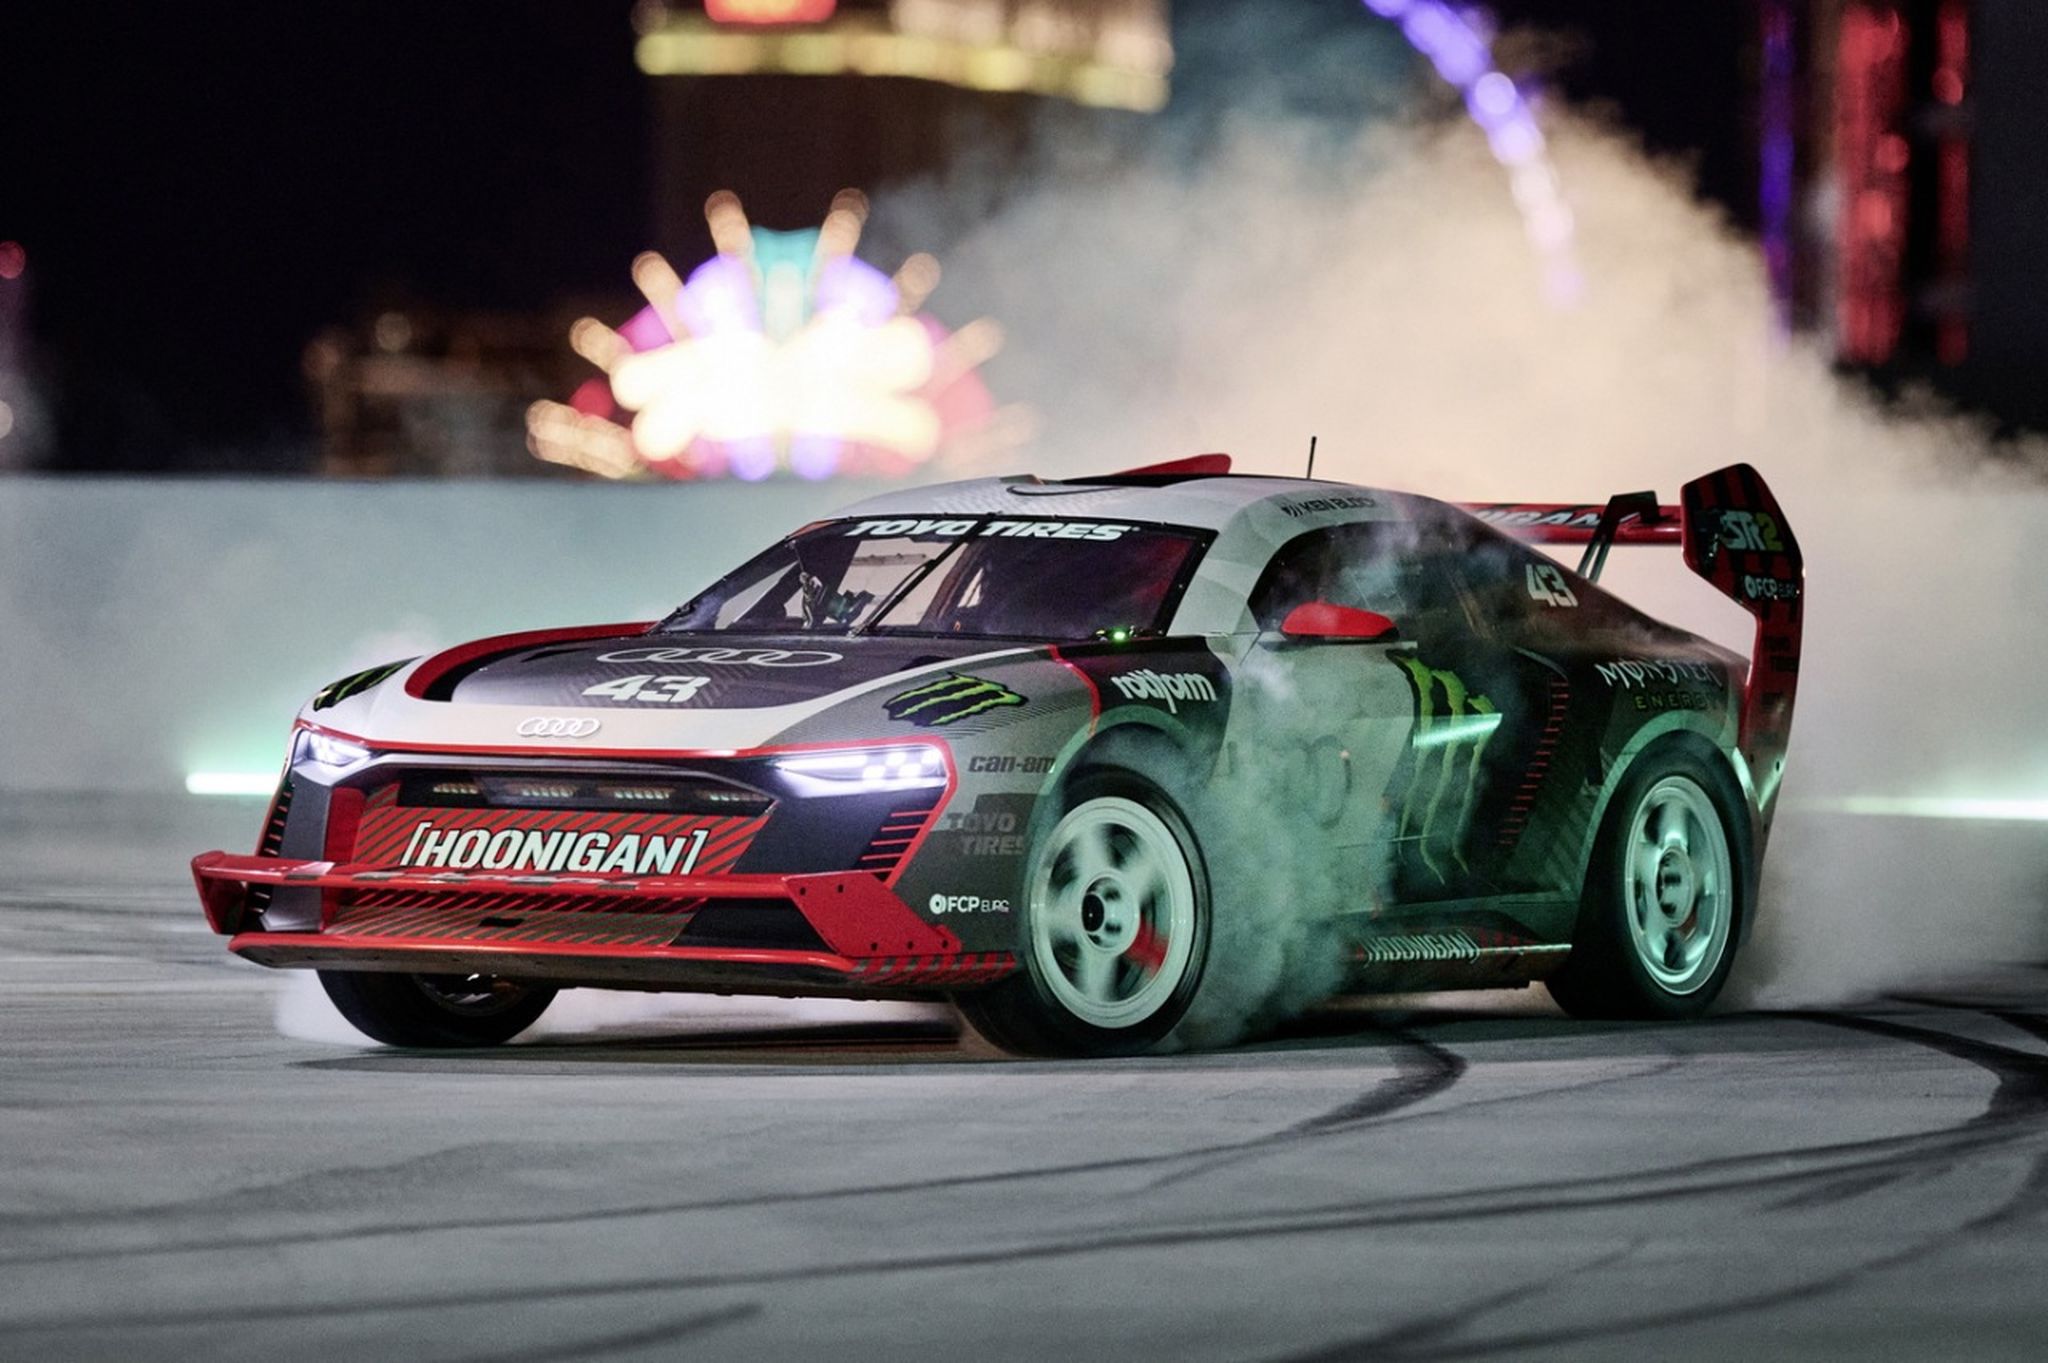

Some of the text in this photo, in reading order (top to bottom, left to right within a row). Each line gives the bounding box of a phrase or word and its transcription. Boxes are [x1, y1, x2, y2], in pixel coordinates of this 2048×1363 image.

[845, 519, 1131, 541] TOYO TIRES
[1525, 563, 1579, 608] 43
[581, 674, 712, 702] 43
[946, 811, 1017, 833] TOYO
[400, 822, 709, 876] [HOONIGAN]
[947, 895, 981, 913] FCP
